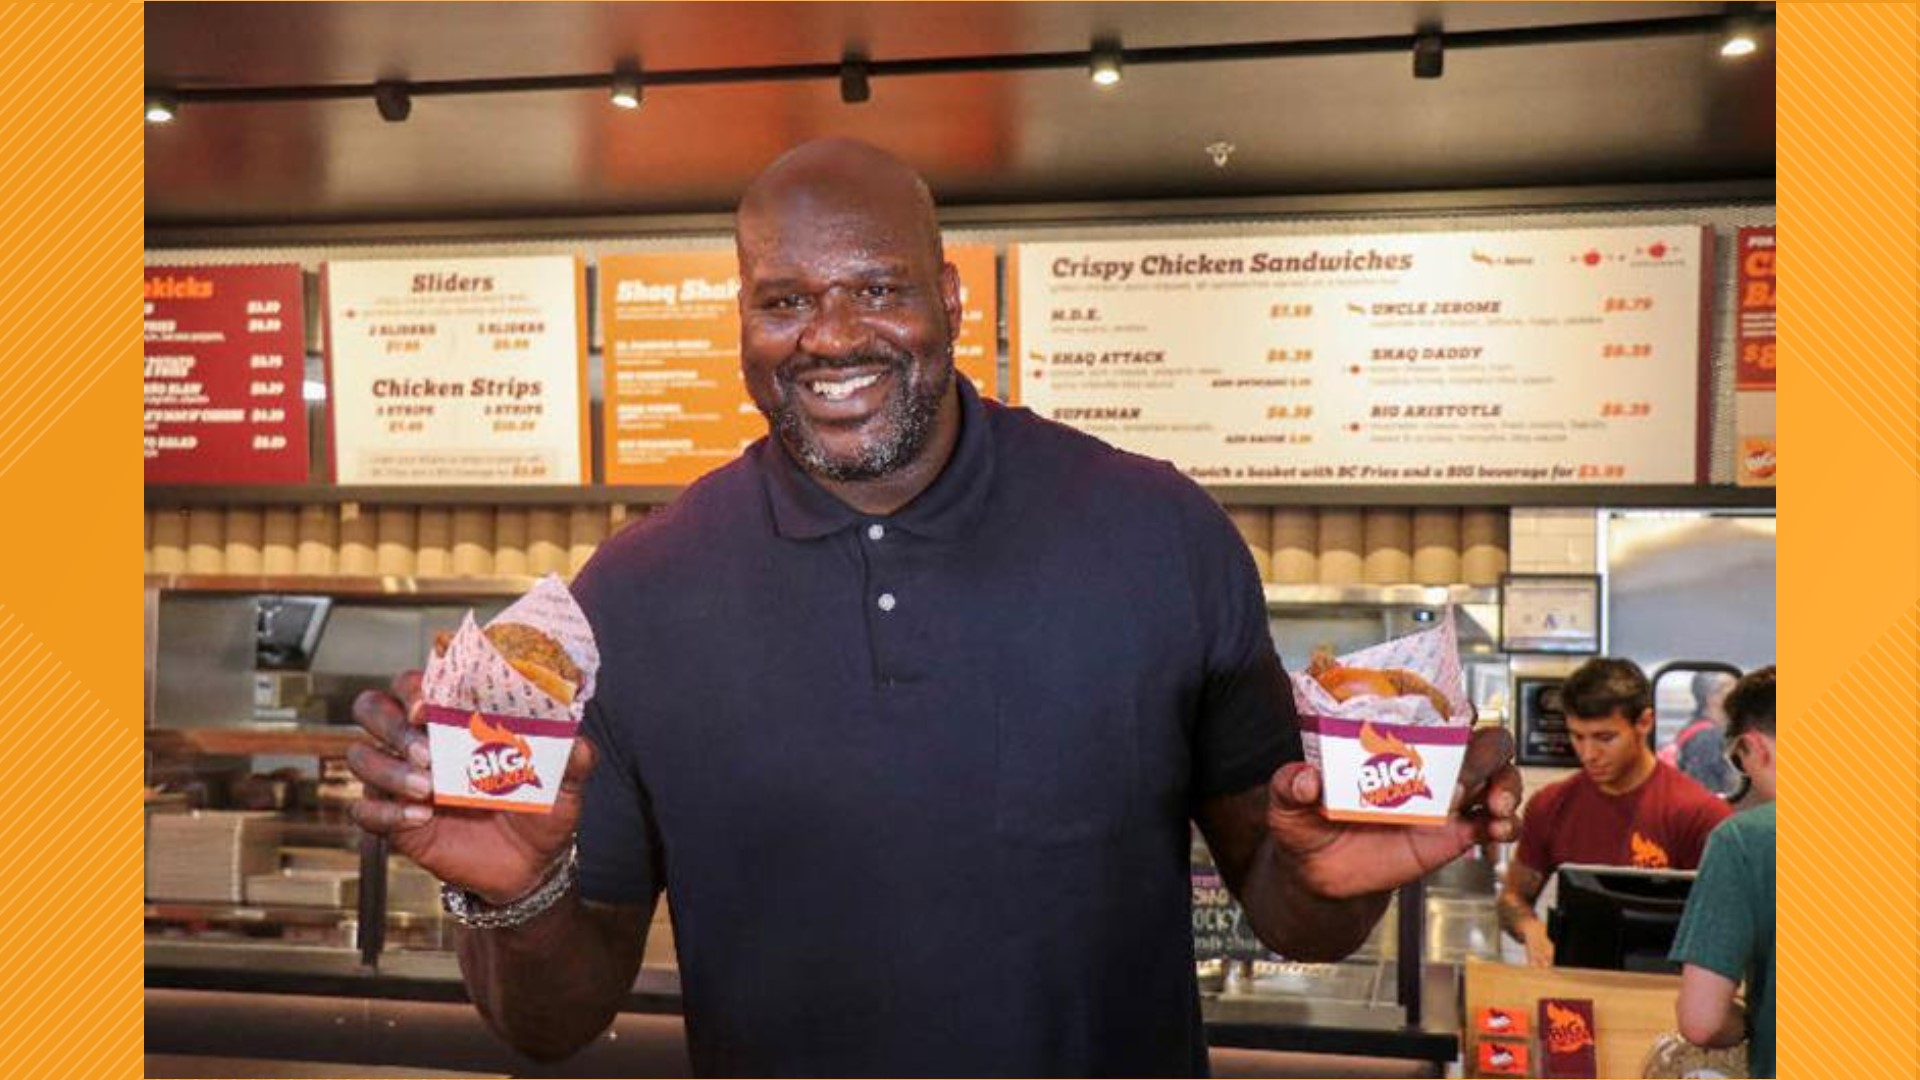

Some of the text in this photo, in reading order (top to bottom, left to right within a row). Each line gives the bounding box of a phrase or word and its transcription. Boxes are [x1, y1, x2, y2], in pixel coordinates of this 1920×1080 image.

[1052, 248, 1414, 281] Crispy Chicken Sandwiches
[411, 272, 495, 294] Sliders
[617, 279, 677, 305] Shaq
[1052, 308, 1101, 322] M.D.E.
[1372, 301, 1502, 315] UNCLE JEROME
[380, 323, 437, 336] SLIDERS
[488, 322, 546, 335] SLIDERS
[1052, 351, 1165, 366] SHAQ ATTACK
[1371, 347, 1484, 362] SHAQ DADDY
[372, 377, 543, 399] Chicken Strips
[494, 404, 544, 416] STRIPS
[1052, 407, 1142, 420] SUPERMAN
[1404, 404, 1503, 418] ARISTOTLE
[1247, 466, 1297, 478] basket
[1300, 465, 1334, 478] with
[1360, 465, 1400, 478] Fries
[1403, 465, 1431, 478] and
[1447, 466, 1475, 478] BIG
[1478, 465, 1549, 480] beverage
[1552, 464, 1574, 480] for
[470, 748, 526, 781] BIG
[1360, 757, 1418, 794] BIG
